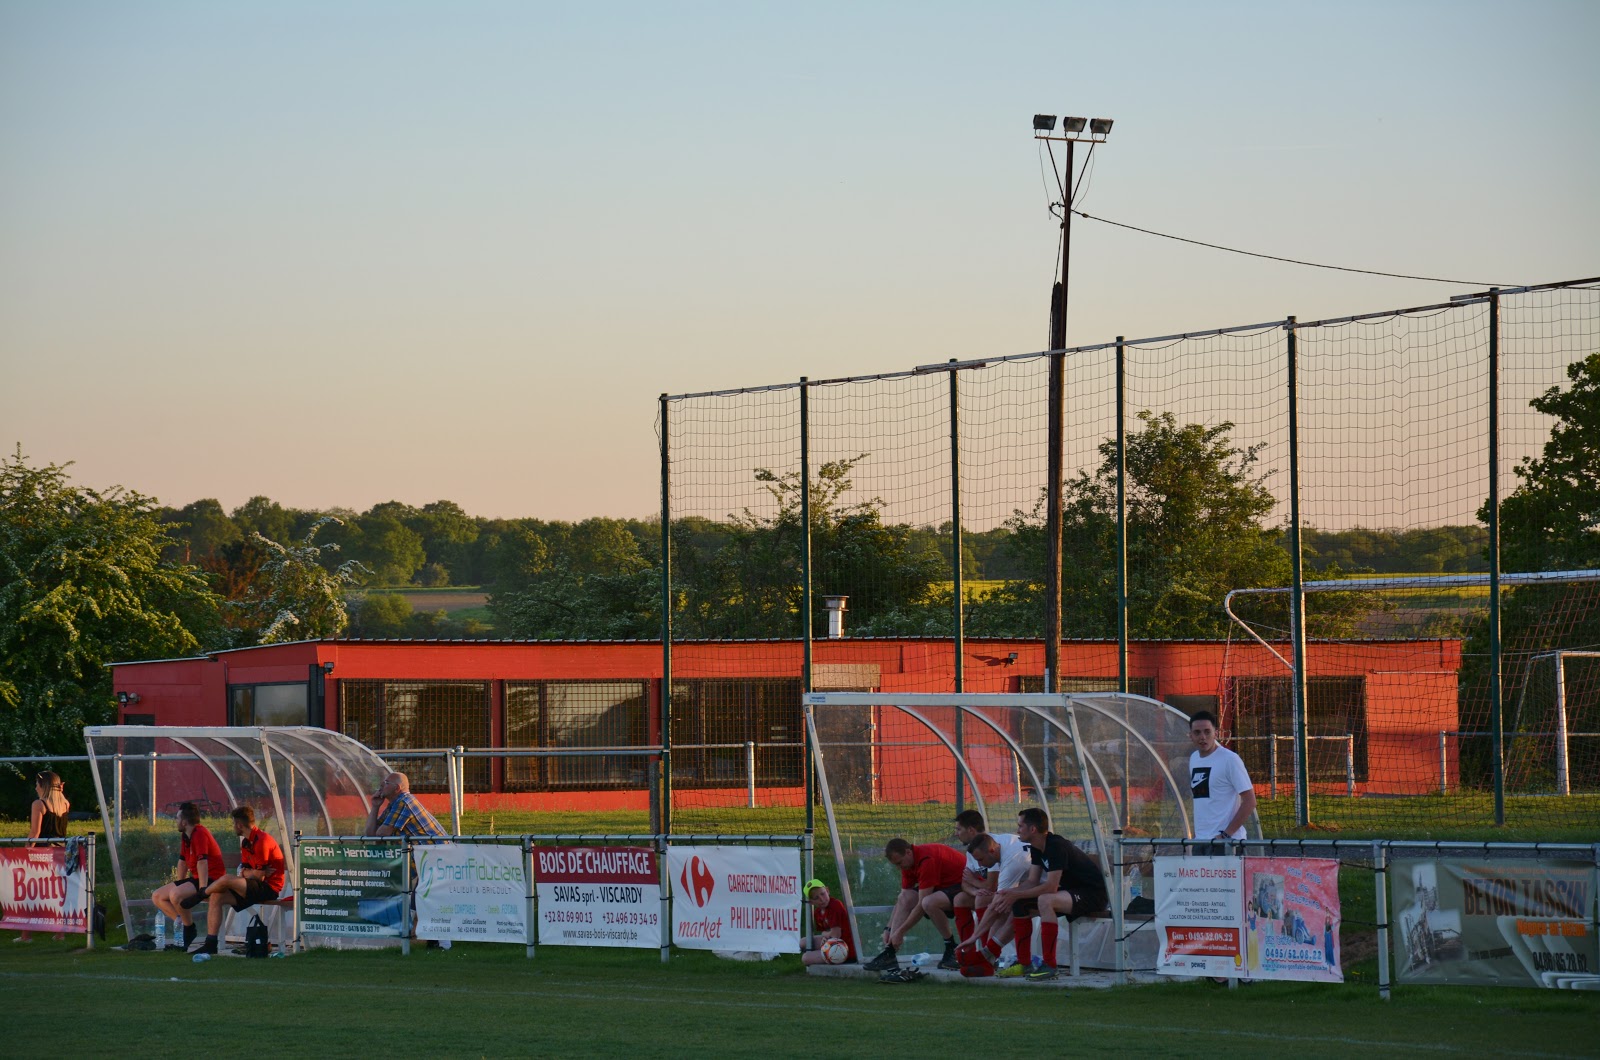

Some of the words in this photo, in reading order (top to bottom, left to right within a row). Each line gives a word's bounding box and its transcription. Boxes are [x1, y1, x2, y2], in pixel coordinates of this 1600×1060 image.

[304, 846, 316, 856] SA
[318, 846, 334, 857] TPH
[384, 848, 394, 858] et
[539, 852, 566, 874] BOIS
[568, 852, 584, 874] DE
[585, 852, 651, 874] CHAUFFAGE
[339, 868, 357, 876] Service
[1178, 868, 1199, 878] MARC
[1200, 868, 1237, 878] DELFOSSE
[12, 867, 68, 907] Bouty
[728, 874, 767, 894] CARREFOUR
[768, 876, 797, 894] MARKET
[554, 886, 580, 902] SAVAS
[582, 890, 595, 906] sprl
[600, 886, 642, 904] VISCARDY
[1462, 878, 1517, 916] BETON
[1521, 880, 1588, 918] TASSIN
[544, 911, 556, 923] +32
[557, 911, 564, 922] 82
[566, 912, 574, 923] 69
[575, 912, 584, 923] 90
[585, 912, 592, 924] 13
[602, 912, 614, 924] +32
[616, 912, 628, 924] 496
[630, 912, 638, 925] 29
[639, 913, 648, 925] 34
[650, 914, 658, 926] 19
[730, 906, 798, 932] PHILIPPEVILLE
[562, 928, 638, 942] www.savas-bois-viscardy.be
[678, 916, 722, 941] market
[1265, 948, 1322, 960] 0495/52.08.22
